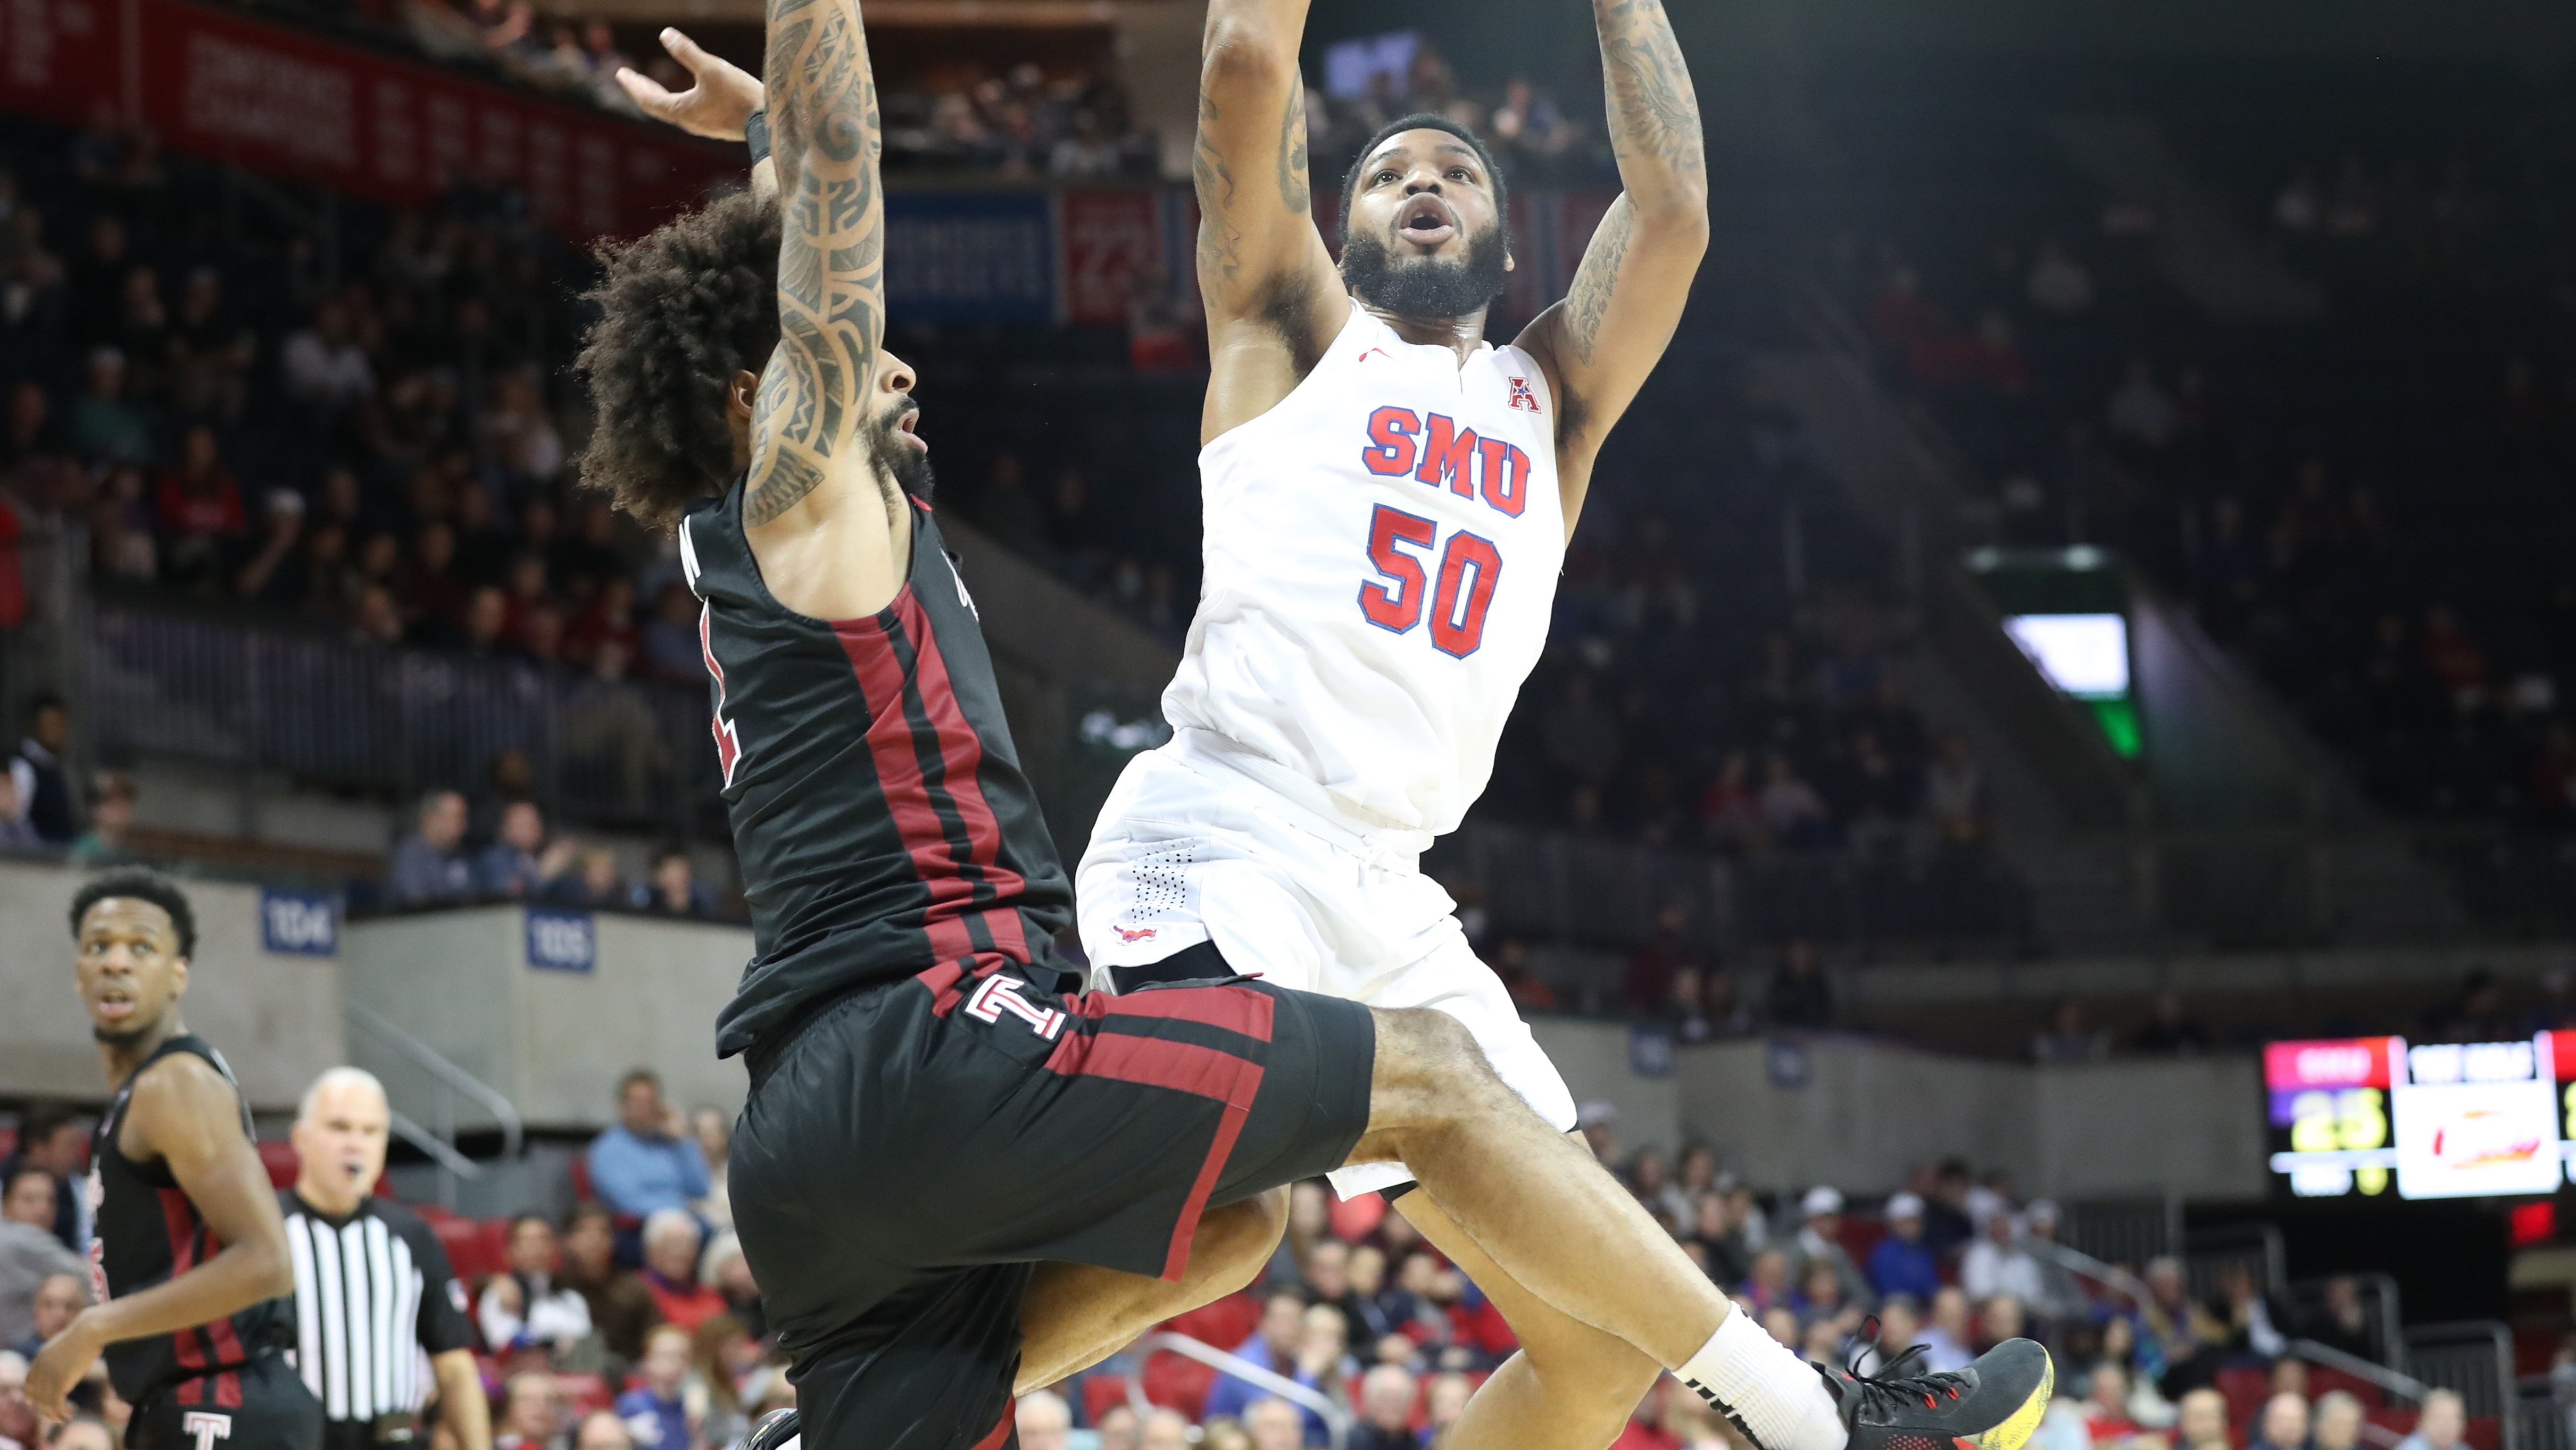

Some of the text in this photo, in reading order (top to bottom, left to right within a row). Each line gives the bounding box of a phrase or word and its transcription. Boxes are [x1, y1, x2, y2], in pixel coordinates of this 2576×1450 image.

[1361, 405, 1531, 519] SMU
[1357, 502, 1502, 660] 50
[963, 973, 1066, 1040] T
[182, 1411, 231, 1450] T
